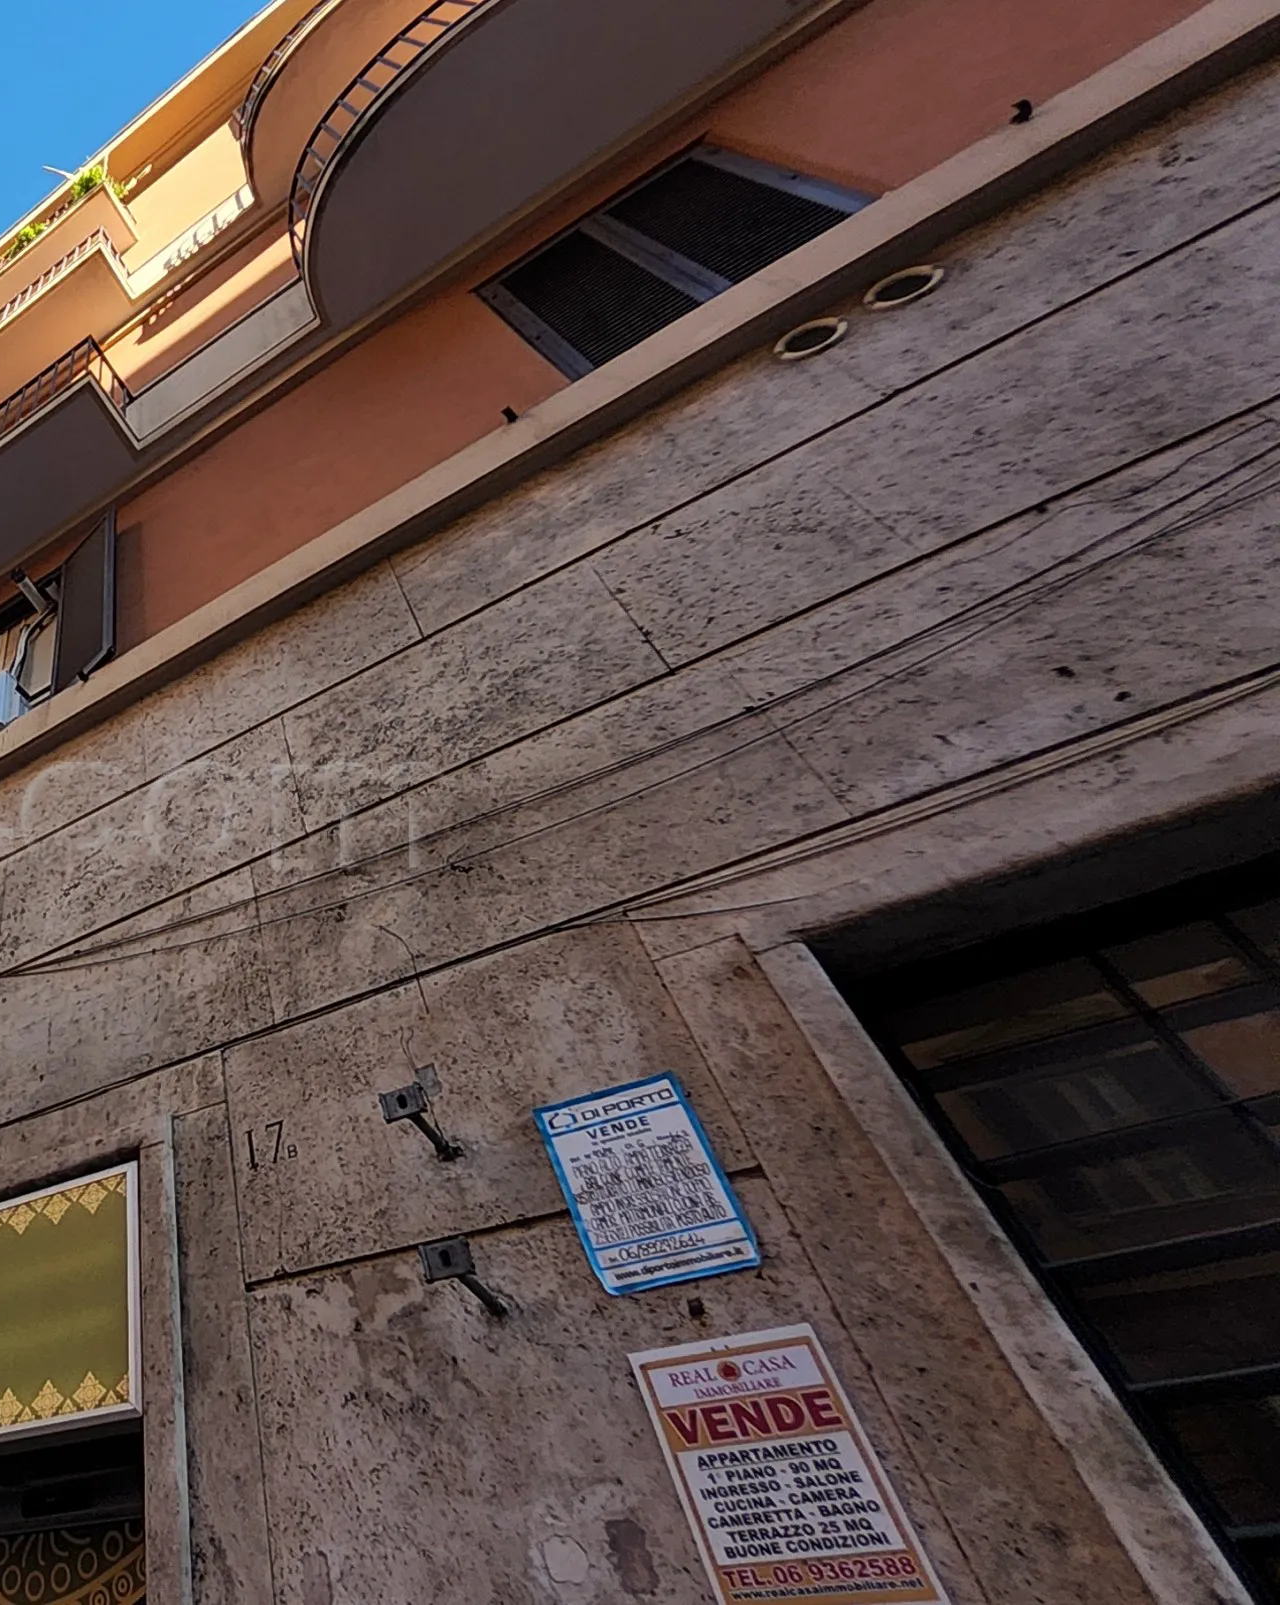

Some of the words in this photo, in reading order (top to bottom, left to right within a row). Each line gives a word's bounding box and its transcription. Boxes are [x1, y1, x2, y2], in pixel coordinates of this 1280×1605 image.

[581, 1108, 602, 1122] DI
[603, 1088, 674, 1117] PORTO
[587, 1116, 651, 1140] VENDE
[668, 1367, 718, 1388] REAL
[742, 1355, 797, 1375] CASA
[694, 1377, 782, 1400] IMMOBILIARE
[666, 1390, 843, 1445] VENDE
[697, 1438, 839, 1469] APPARTAMENTO
[727, 1466, 777, 1482] PIANO
[789, 1462, 811, 1475] 90
[816, 1458, 843, 1473] MQ
[700, 1481, 781, 1501] INGRESSO
[796, 1471, 864, 1490] SALONE
[714, 1498, 776, 1514] CUCINA
[788, 1487, 862, 1506] CAMERA
[707, 1509, 806, 1530] CAMERETTA
[820, 1500, 881, 1518] BAGNO
[726, 1524, 815, 1544] TERRAZZO
[820, 1521, 840, 1535] 25
[847, 1517, 874, 1532] MQ
[723, 1542, 783, 1560] BUONE
[786, 1532, 891, 1552] CONDIZIONI
[810, 1556, 917, 1583] 9362588
